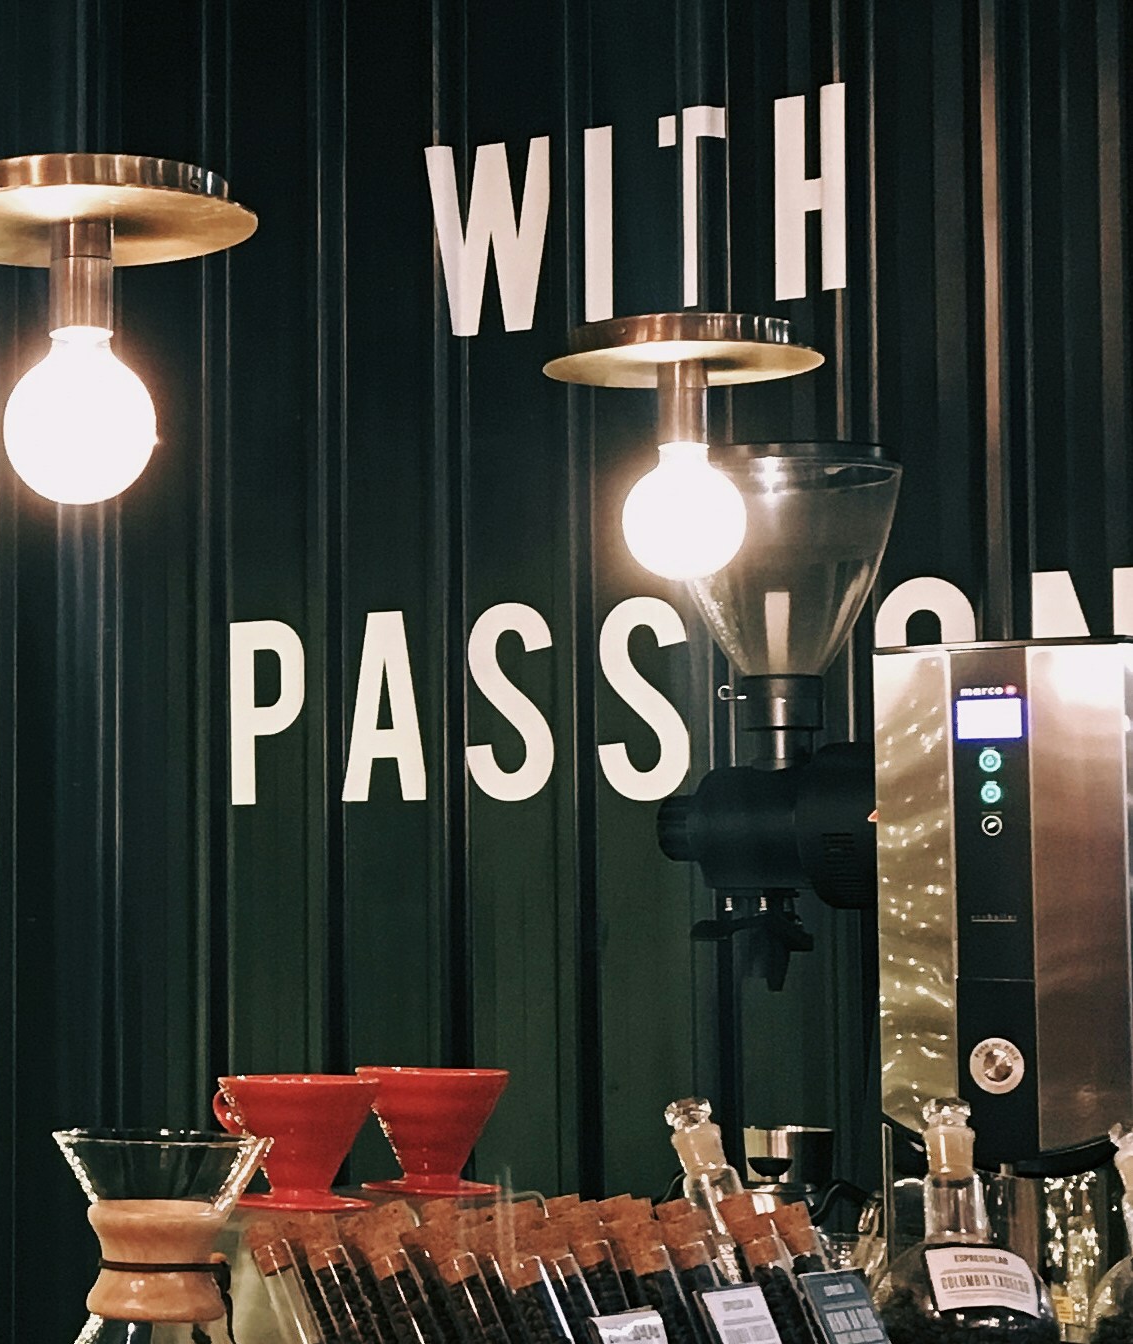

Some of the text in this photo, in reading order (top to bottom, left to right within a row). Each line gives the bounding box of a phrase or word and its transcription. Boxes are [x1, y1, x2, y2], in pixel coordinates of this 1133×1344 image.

[424, 83, 846, 337] WITH
[960, 687, 1004, 697] marco
[941, 1275, 990, 1290] COLOMBIA
